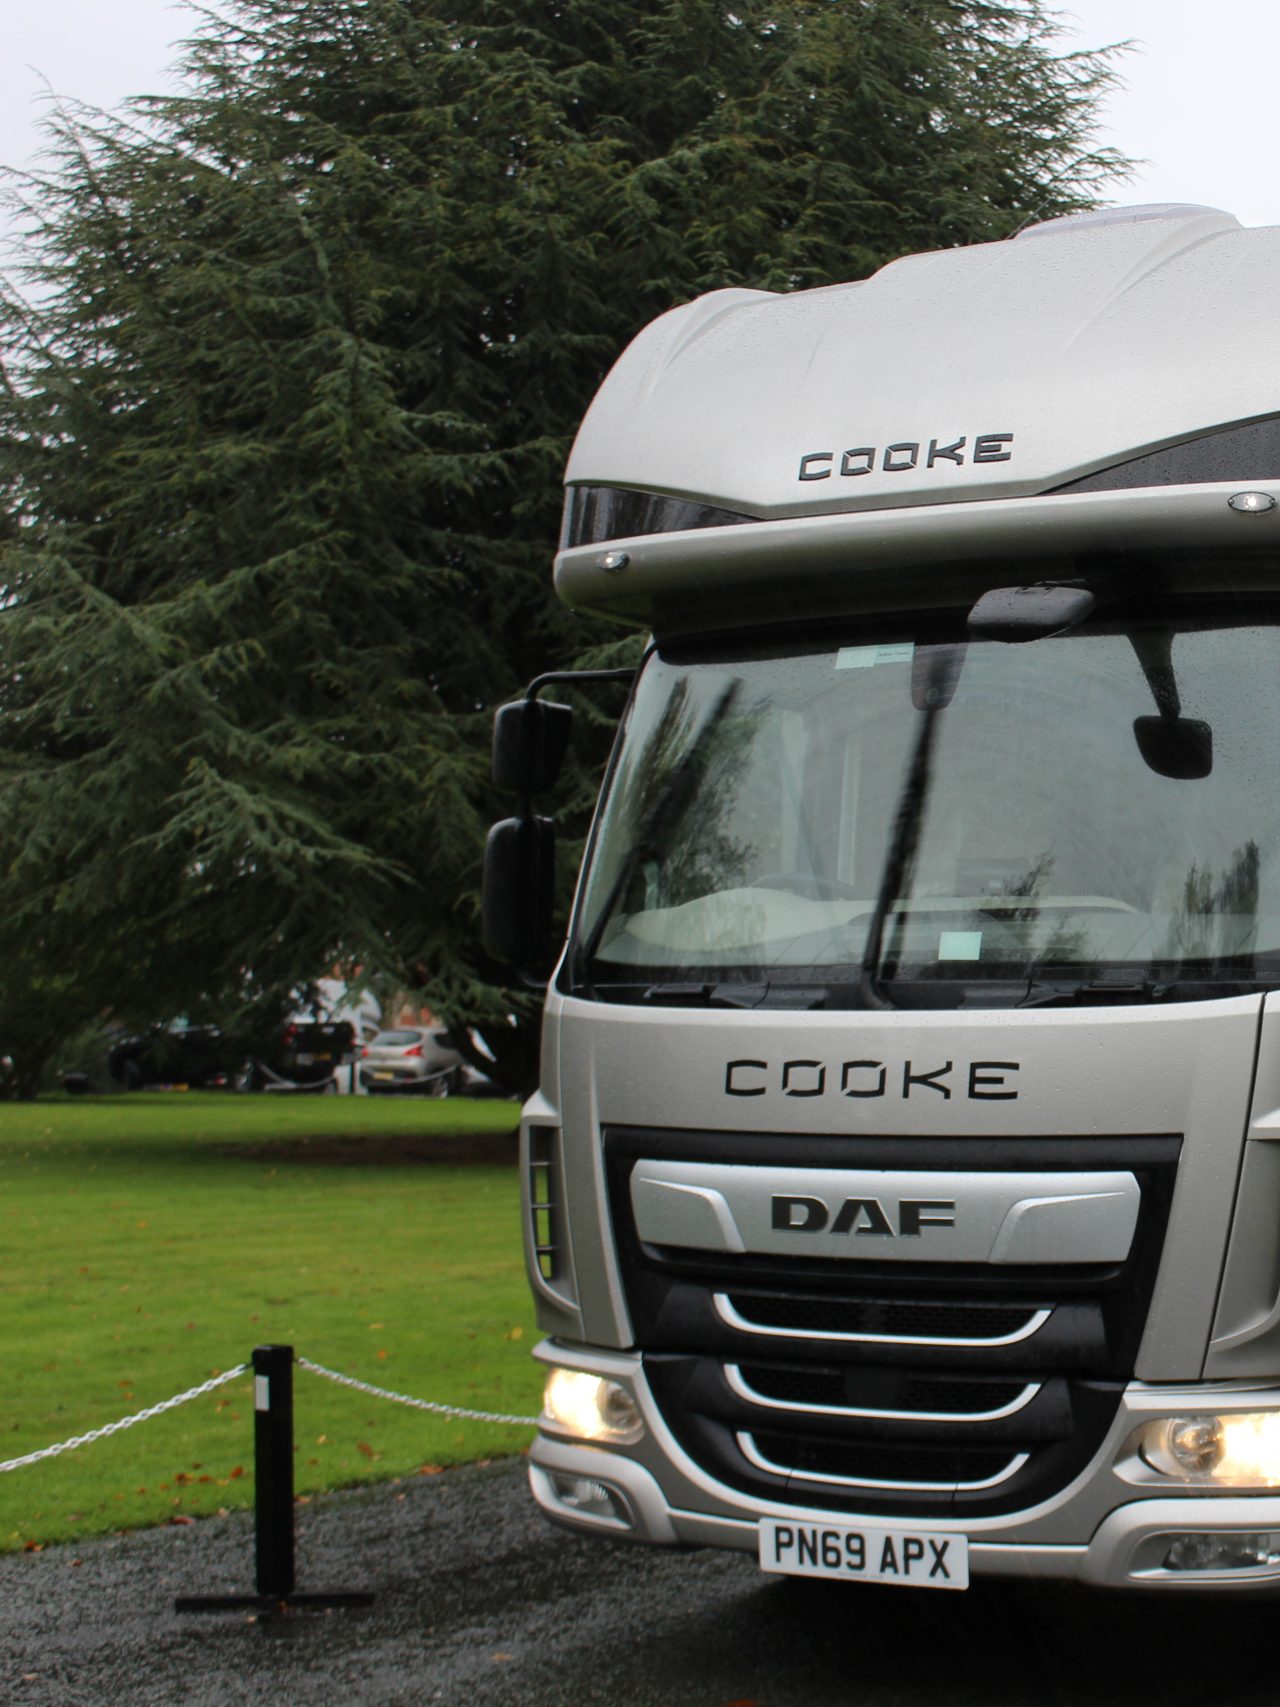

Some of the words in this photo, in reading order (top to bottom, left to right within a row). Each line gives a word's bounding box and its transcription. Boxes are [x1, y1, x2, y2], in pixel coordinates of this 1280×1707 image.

[799, 433, 1013, 481] COOKE
[725, 1059, 1020, 1101] COOKE
[772, 1195, 956, 1237] DAF
[775, 1526, 865, 1571] PN69
[880, 1535, 950, 1578] APX
